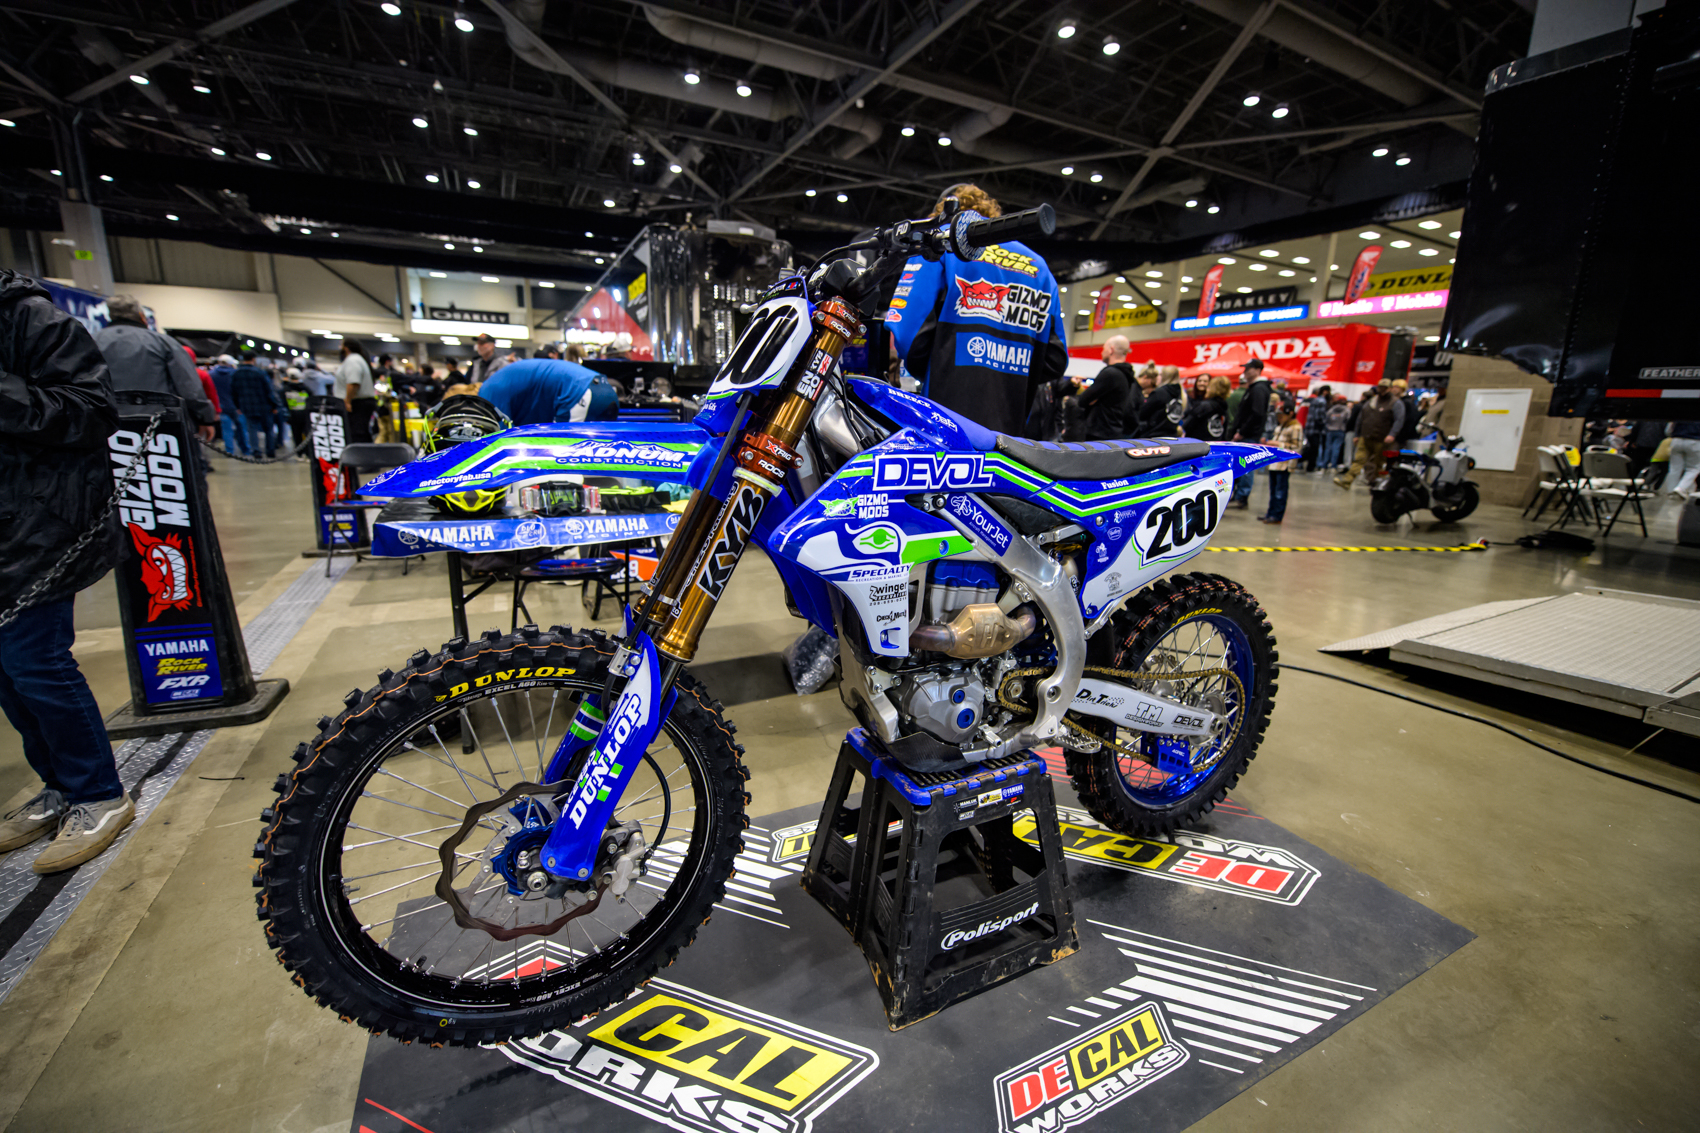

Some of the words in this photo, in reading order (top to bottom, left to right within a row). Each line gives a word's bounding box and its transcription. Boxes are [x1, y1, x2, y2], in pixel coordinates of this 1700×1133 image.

[981, 250, 1038, 274] RIVER
[1379, 272, 1449, 290] DUNL
[836, 305, 857, 323] XTRIG
[1005, 305, 1047, 332] MODS
[974, 358, 1029, 373] RACING
[767, 440, 793, 461] XTRIG
[1127, 446, 1170, 457] GUTS
[557, 457, 682, 468] CONSTRUCTION
[758, 459, 785, 478] ROCS
[107, 429, 156, 530] GIZMO
[148, 433, 191, 527] MODS
[419, 472, 491, 487] @factoryfab.usa
[873, 454, 993, 491] DEVOL
[1101, 479, 1129, 490] Fusion
[857, 494, 888, 506] GIZMO
[858, 506, 889, 519] MODS
[584, 518, 649, 533] YAMAHA
[971, 506, 1010, 549] YourJet
[1145, 489, 1218, 560] 200
[419, 526, 494, 543] YAMAHA
[697, 485, 764, 601] KYB
[852, 564, 912, 578] SPECIALTY
[144, 639, 209, 656] YAMAHA
[155, 663, 208, 676] RIVER
[157, 657, 204, 668] ROCK
[157, 674, 210, 690] FXR
[450, 667, 576, 698] DUNLOP
[485, 684, 516, 695] EXCEL
[1135, 701, 1163, 722] TM
[1173, 715, 1204, 728] DEVOL
[569, 694, 641, 829] DUNLOP
[941, 902, 1039, 950] Polisport
[614, 1005, 818, 1102] CAL
[519, 1029, 790, 1133] ORKS
